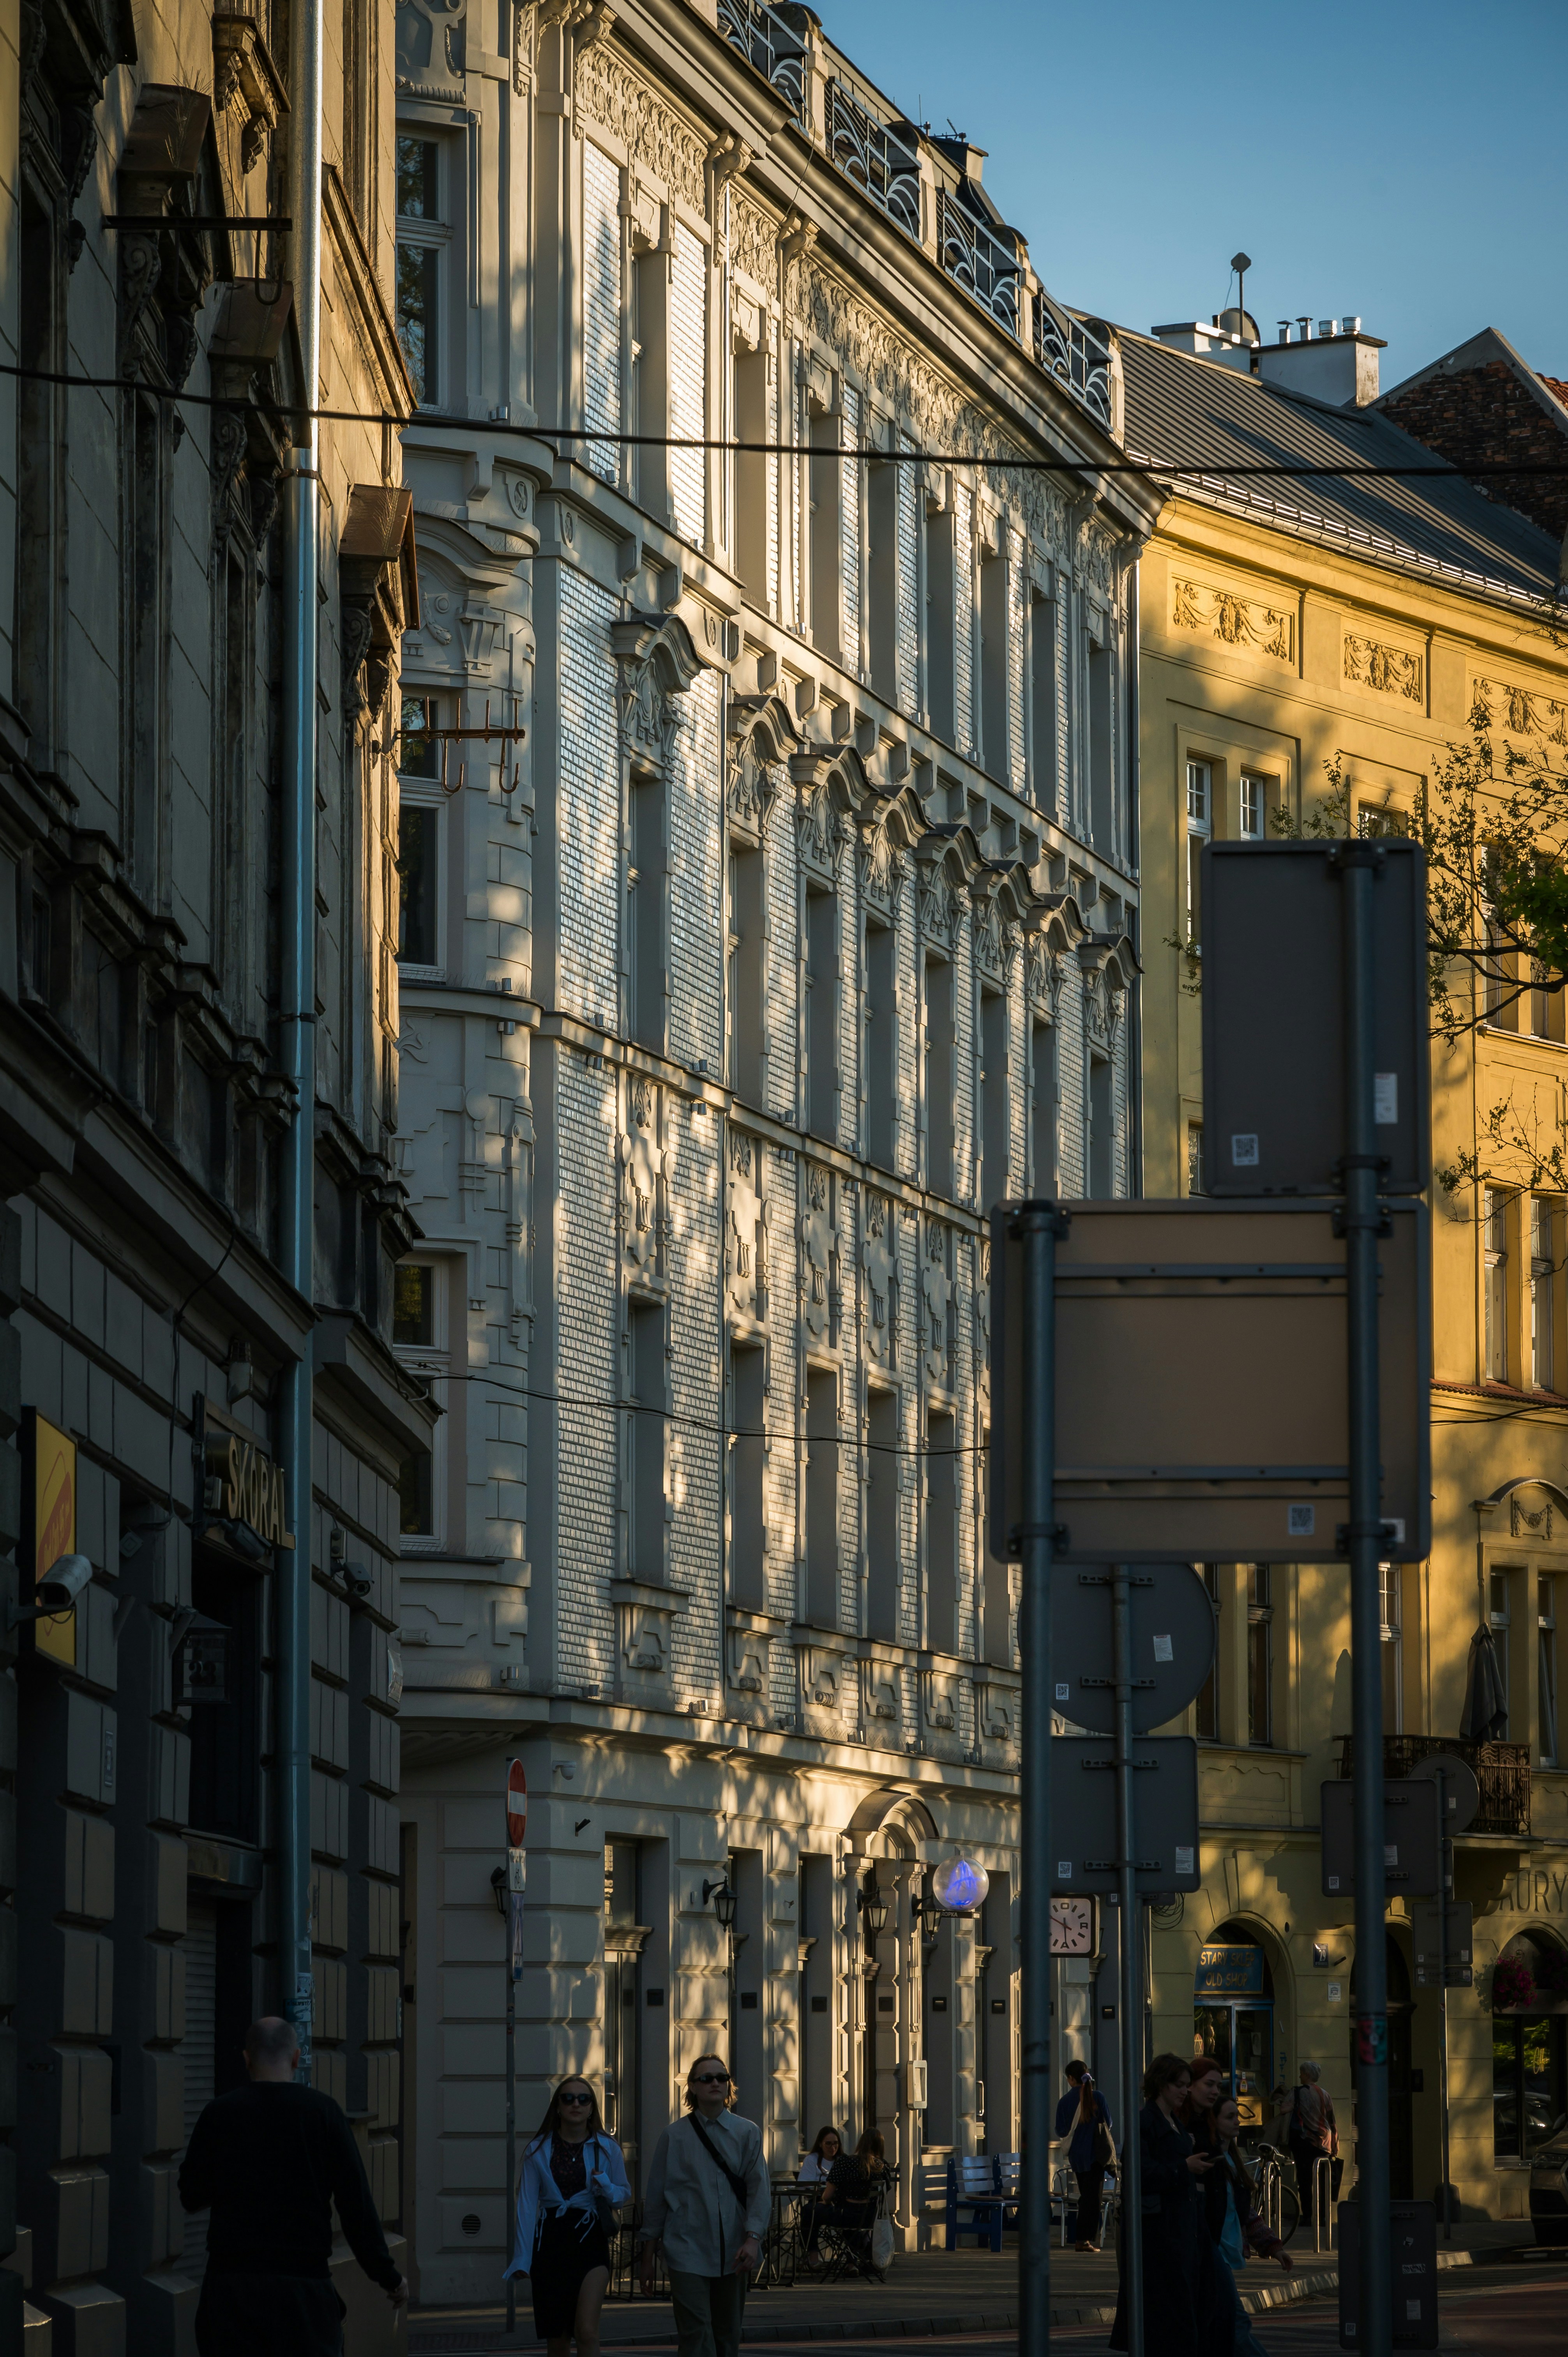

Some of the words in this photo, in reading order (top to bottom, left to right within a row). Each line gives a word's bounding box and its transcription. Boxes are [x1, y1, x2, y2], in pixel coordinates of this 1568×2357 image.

[228, 1436, 296, 1550] SKORAL
[1200, 1951, 1227, 1966] STARY
[1231, 1952, 1255, 1967] SKLEP
[1206, 1972, 1222, 1987] OLD
[1225, 1972, 1248, 1987] SHOP
